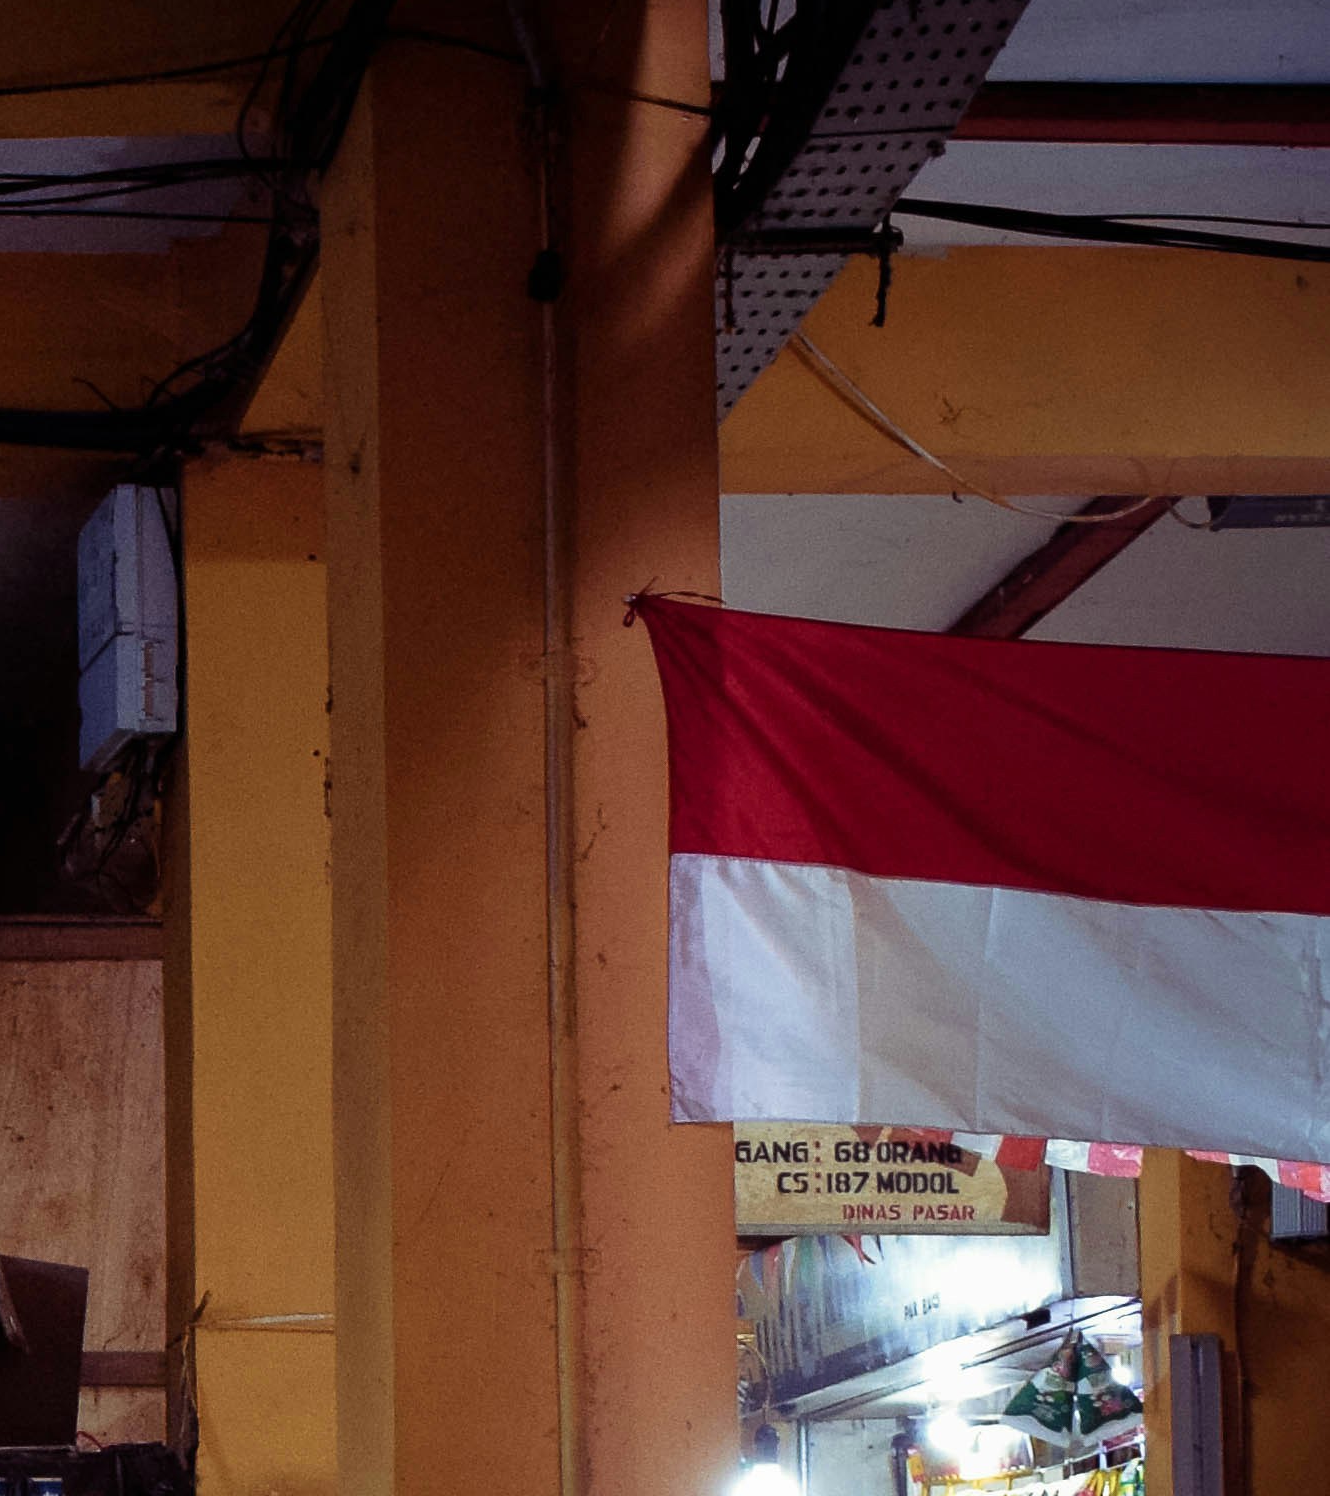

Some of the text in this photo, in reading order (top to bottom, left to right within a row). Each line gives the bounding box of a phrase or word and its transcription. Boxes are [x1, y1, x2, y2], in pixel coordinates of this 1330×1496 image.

[835, 1141, 870, 1162] 68
[877, 1142, 962, 1164] ORANG
[826, 1172, 870, 1194] 187
[877, 1172, 960, 1195] MODOL
[842, 1205, 975, 1221] DINAS PASAR
